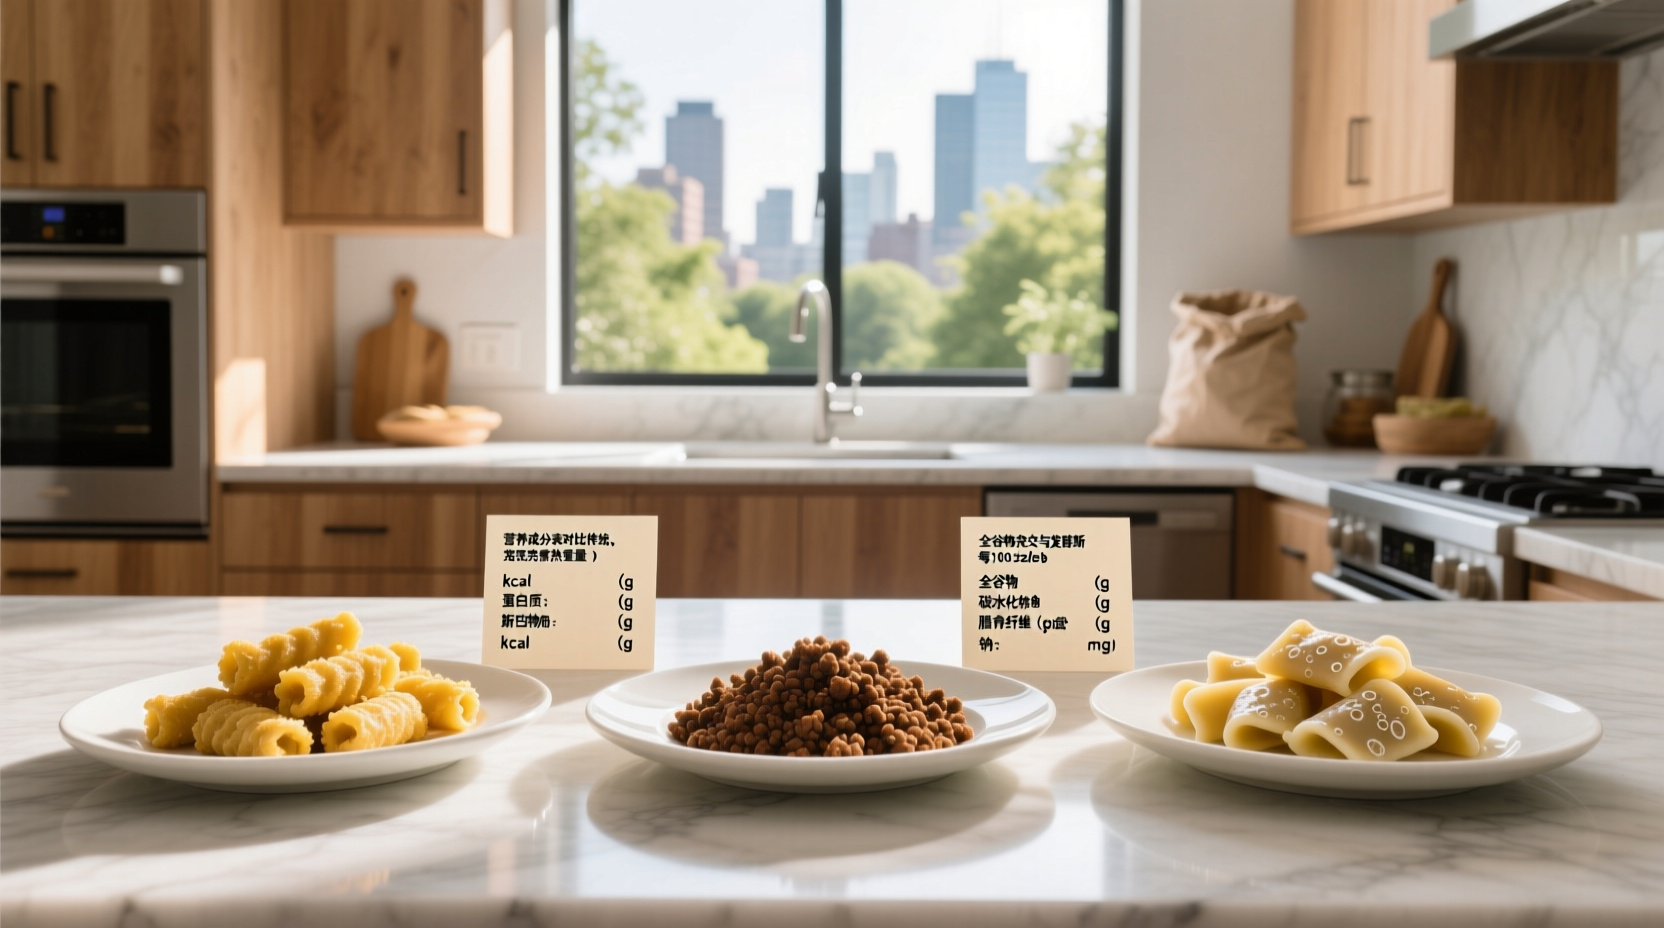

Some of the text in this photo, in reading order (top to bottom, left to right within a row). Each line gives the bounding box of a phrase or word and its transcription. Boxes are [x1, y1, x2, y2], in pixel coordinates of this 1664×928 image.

[503, 573, 633, 591] kcal (g
[1095, 575, 1109, 592] (g
[619, 594, 633, 611] (g
[1096, 595, 1109, 613] (g
[618, 614, 632, 631] (g
[1096, 616, 1110, 633] (g
[501, 635, 632, 652] kcal (g
[1088, 639, 1115, 654] mg)
